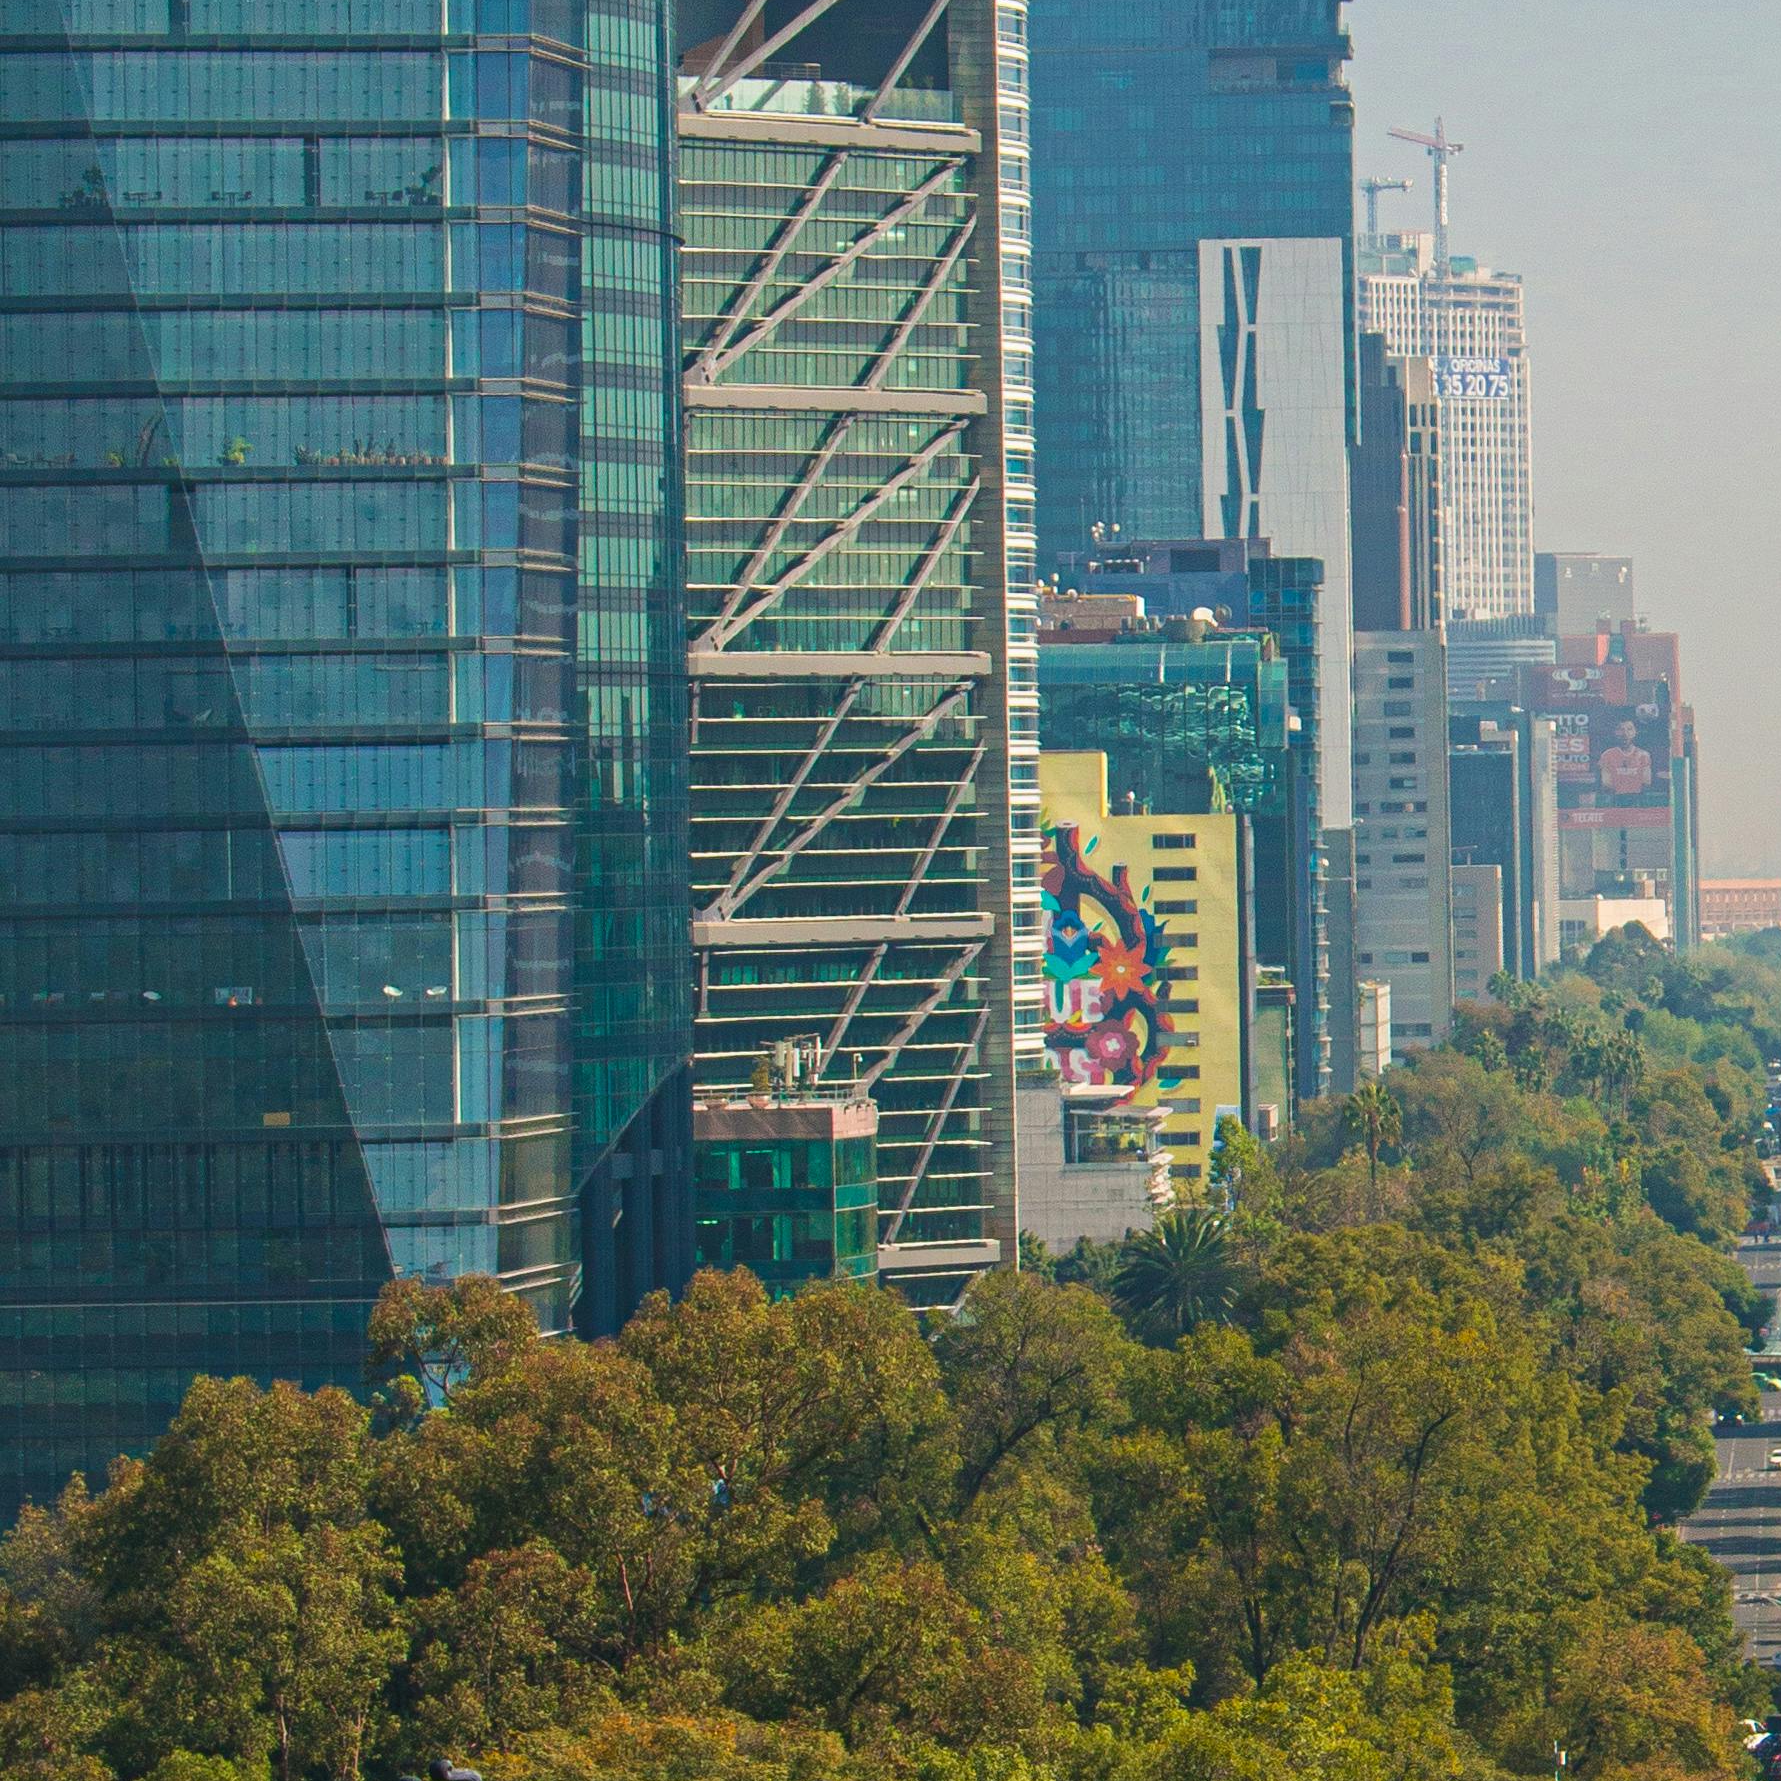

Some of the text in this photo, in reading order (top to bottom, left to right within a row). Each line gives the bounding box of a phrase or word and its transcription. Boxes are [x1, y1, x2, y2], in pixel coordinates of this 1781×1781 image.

[1451, 358, 1501, 373] OFICINAS
[1465, 374, 1487, 396] 20
[1488, 375, 1508, 397] 75
